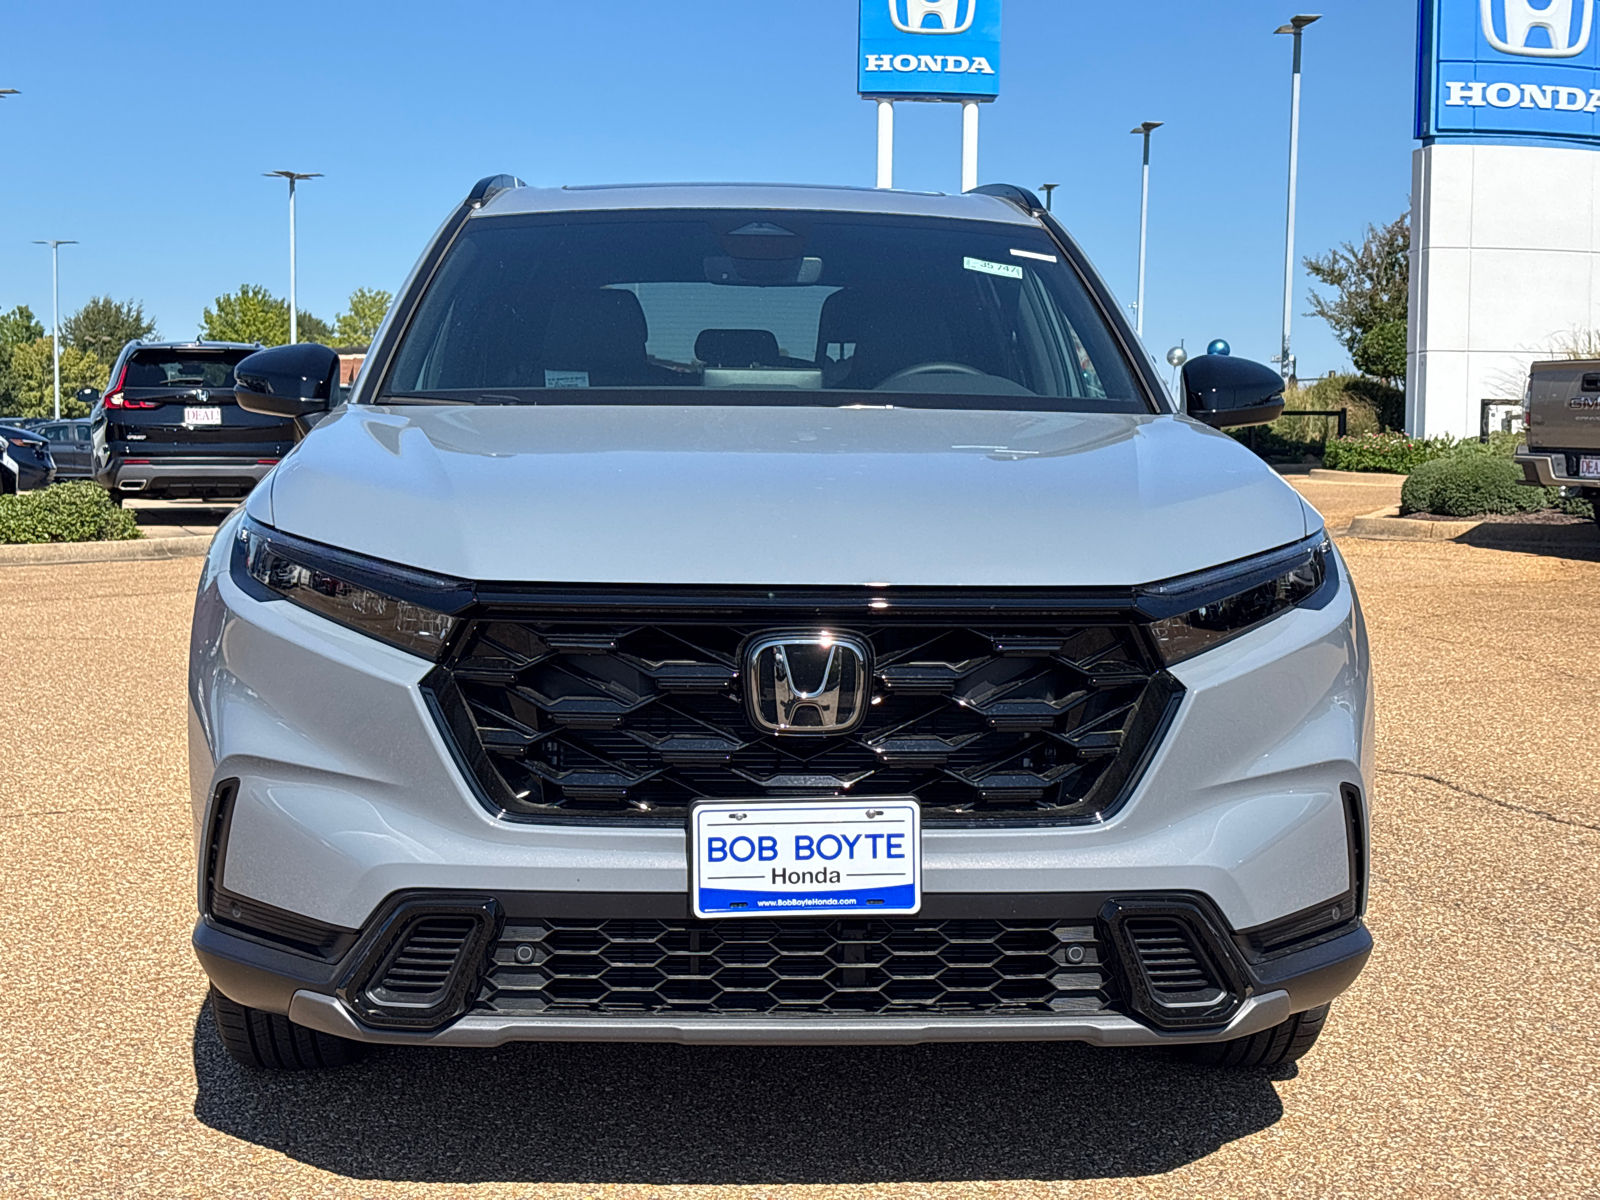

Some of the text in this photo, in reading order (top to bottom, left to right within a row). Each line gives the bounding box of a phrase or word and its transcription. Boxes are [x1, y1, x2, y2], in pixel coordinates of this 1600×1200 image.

[865, 54, 995, 74] HONDA
[187, 409, 219, 421] DEAL!
[1581, 460, 1600, 474] DEA
[708, 833, 905, 862] BOB BOYTE
[771, 867, 841, 884] Honda
[757, 898, 857, 907] www.BobBoyteHonda.com
